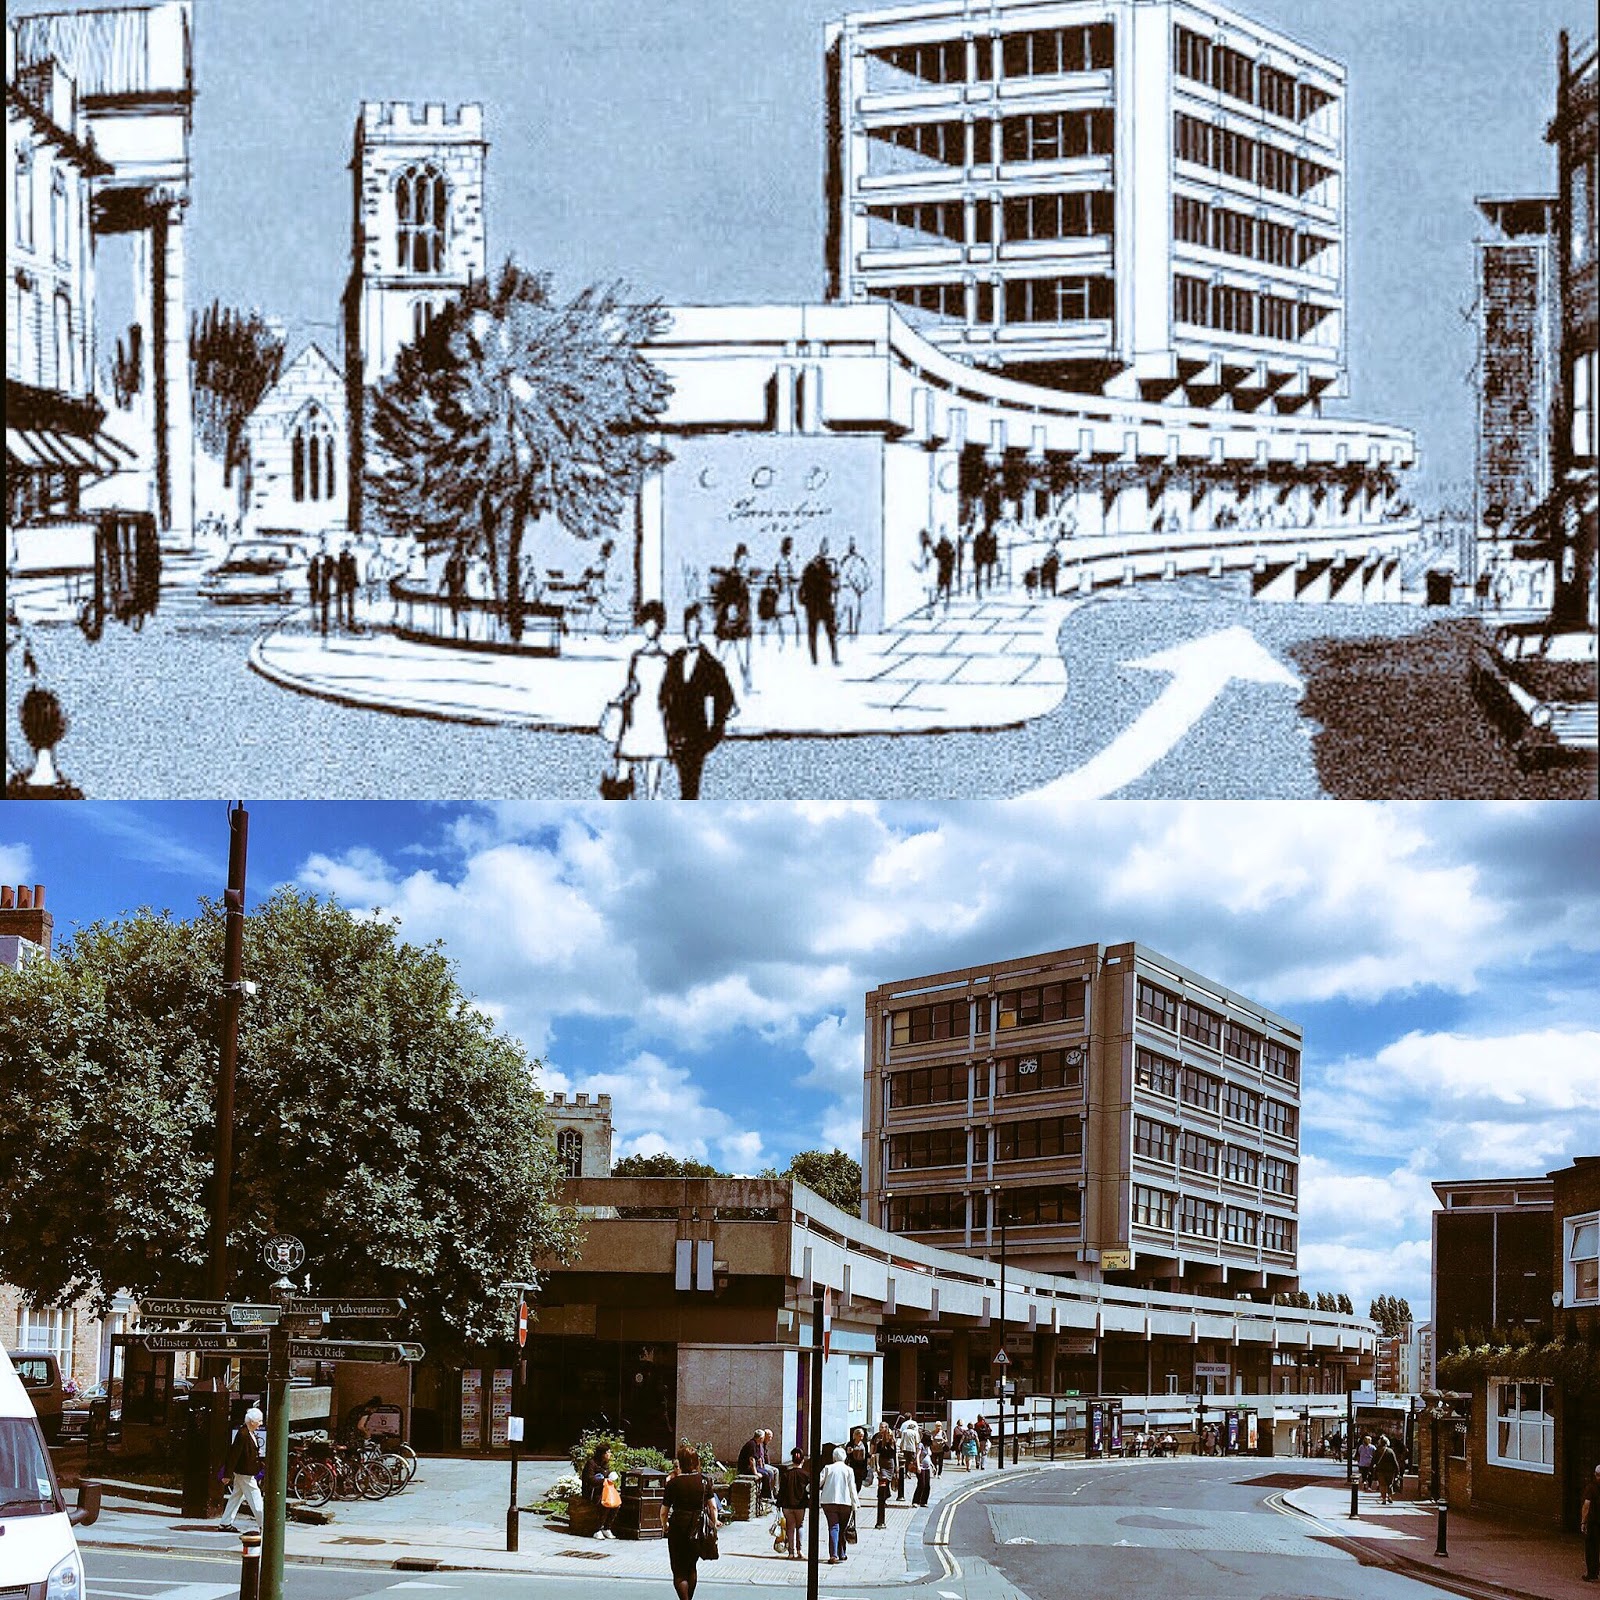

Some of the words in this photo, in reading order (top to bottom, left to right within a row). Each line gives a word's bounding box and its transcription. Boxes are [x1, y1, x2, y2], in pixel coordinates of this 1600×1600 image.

[273, 1263, 295, 1272] YORK
[146, 1301, 181, 1313] York's
[184, 1304, 217, 1315] Sweet
[292, 1303, 333, 1314] Merchant
[336, 1303, 390, 1314] Adventurers
[152, 1337, 190, 1348] Minster
[194, 1337, 219, 1347] Area
[887, 1334, 929, 1344] HAVANA
[292, 1345, 313, 1356] Park
[313, 1346, 323, 1357] &
[324, 1346, 346, 1358] Ride
